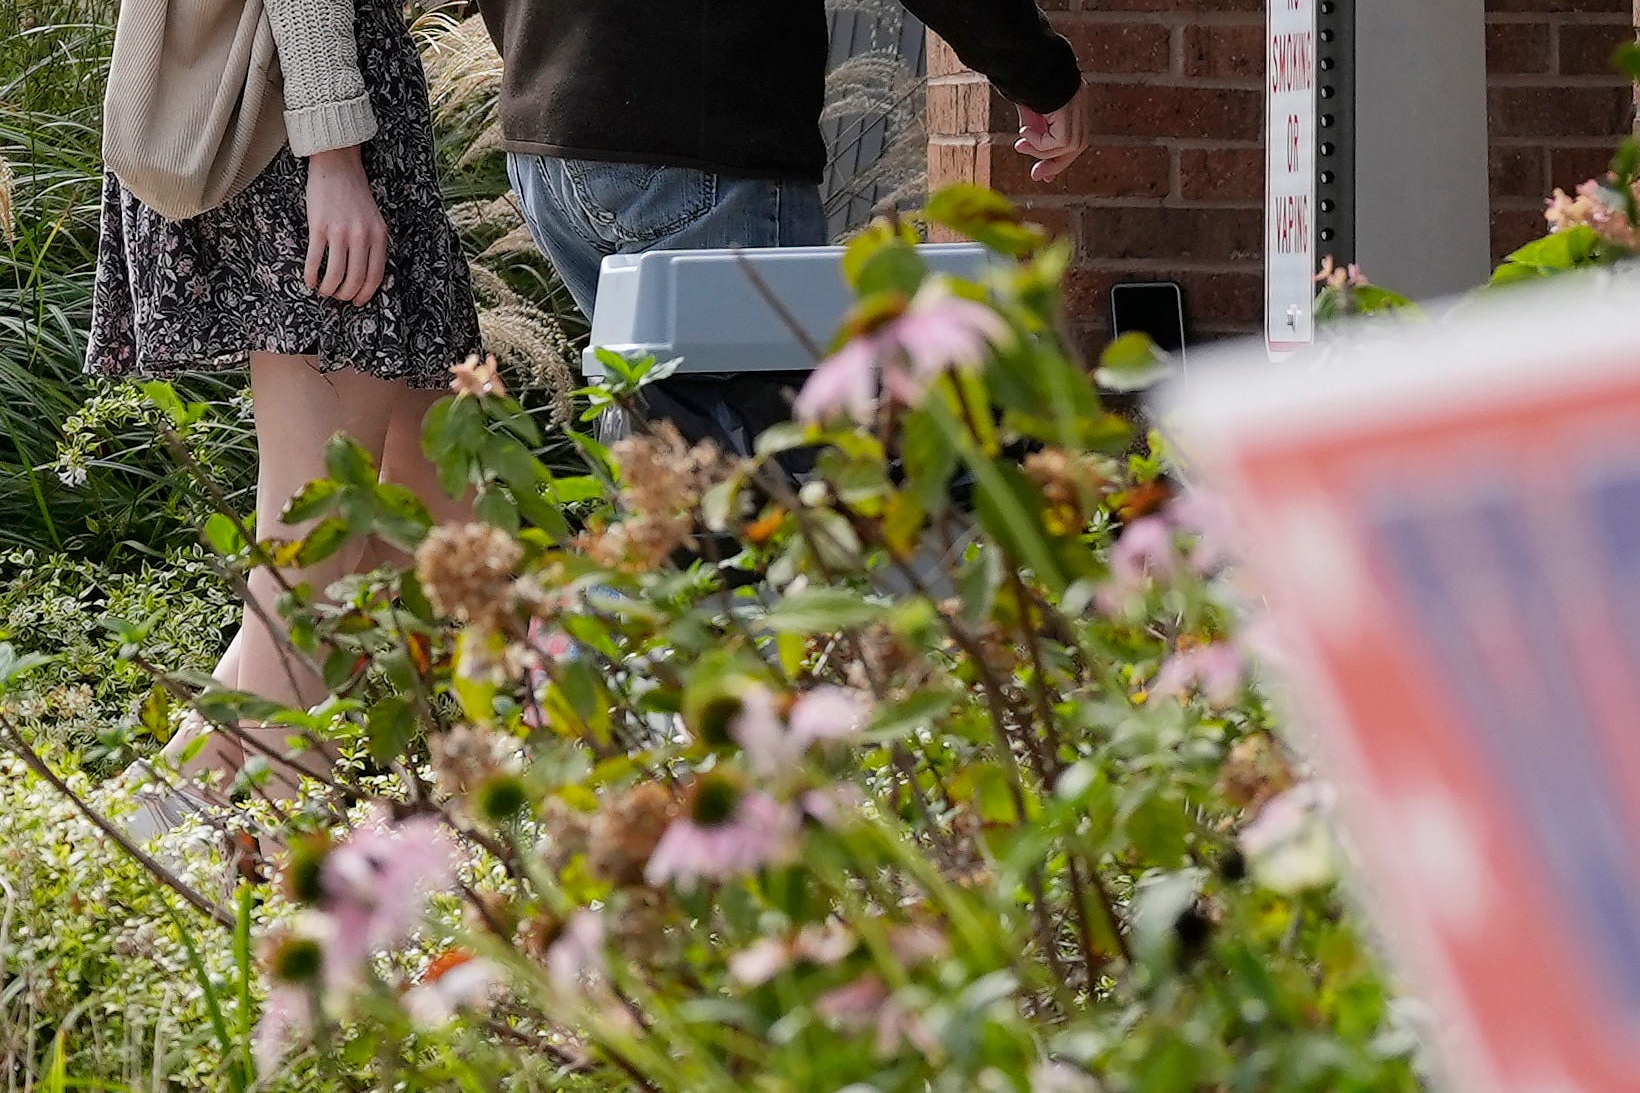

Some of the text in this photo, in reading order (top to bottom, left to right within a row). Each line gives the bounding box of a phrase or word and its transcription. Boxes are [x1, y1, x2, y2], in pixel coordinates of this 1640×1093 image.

[1271, 30, 1313, 94] SMOKING
[1286, 113, 1300, 174] OR
[1275, 193, 1309, 254] VAPING
